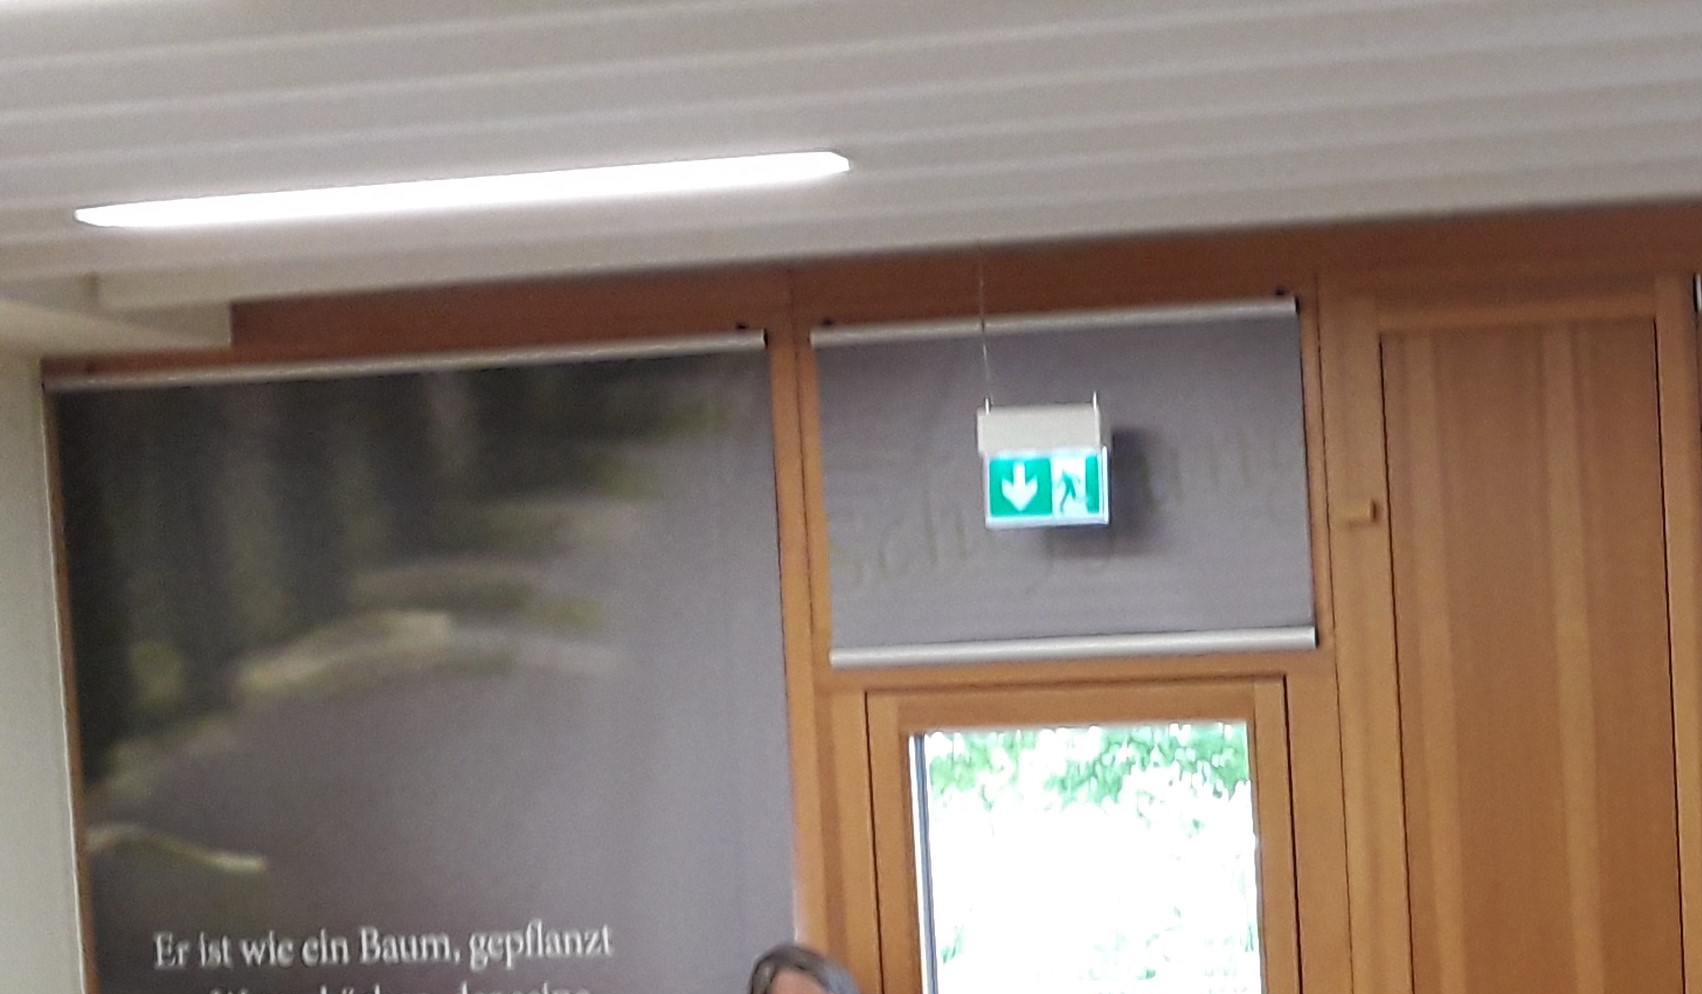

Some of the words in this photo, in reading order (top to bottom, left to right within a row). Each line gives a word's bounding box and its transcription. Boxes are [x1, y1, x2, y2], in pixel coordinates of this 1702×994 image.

[153, 931, 190, 969] Er
[199, 931, 233, 968] ist
[241, 928, 294, 968] wie
[302, 927, 349, 967] ein
[359, 925, 461, 967] Baum,
[468, 919, 615, 970] gepflanzt
